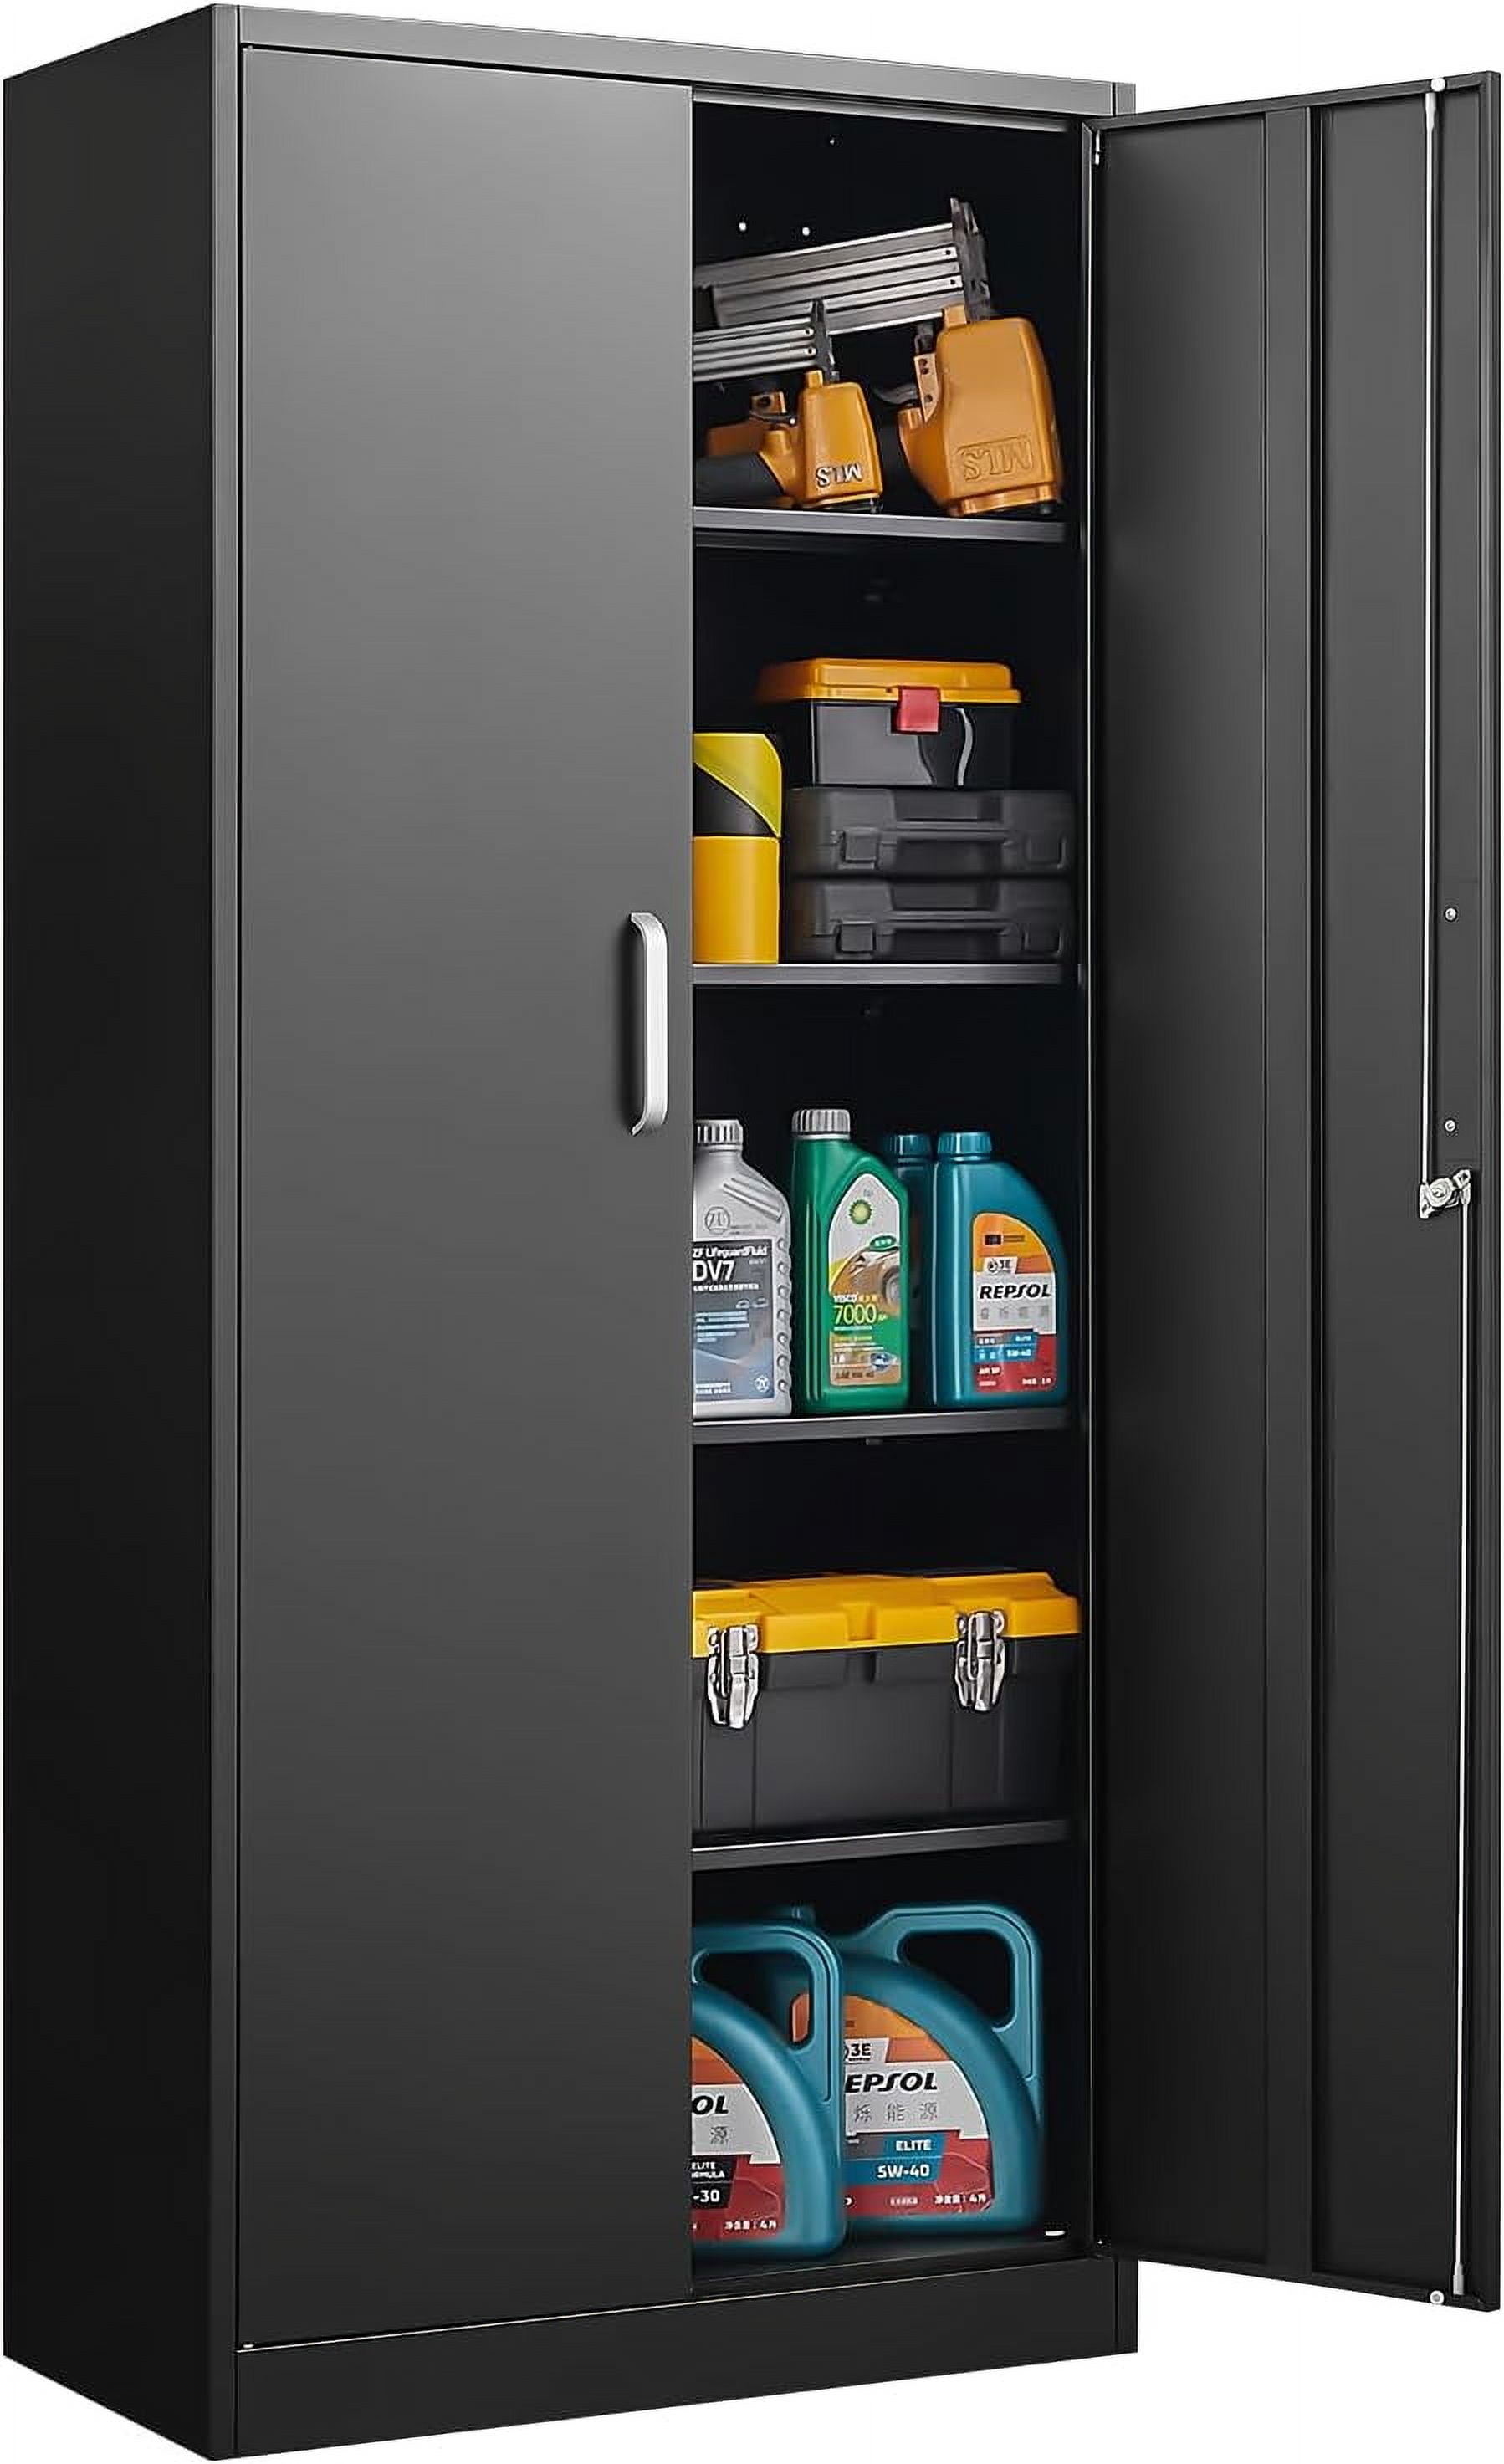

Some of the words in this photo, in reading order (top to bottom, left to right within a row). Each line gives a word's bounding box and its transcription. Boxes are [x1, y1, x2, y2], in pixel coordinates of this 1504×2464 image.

[693, 1260, 735, 1281] DV7
[979, 1283, 1051, 1300] REPSOL
[833, 1303, 877, 1325] 7000
[850, 2042, 871, 2056] 3E
[896, 2139, 933, 2152] ELITE
[877, 2163, 930, 2179] 5W-40
